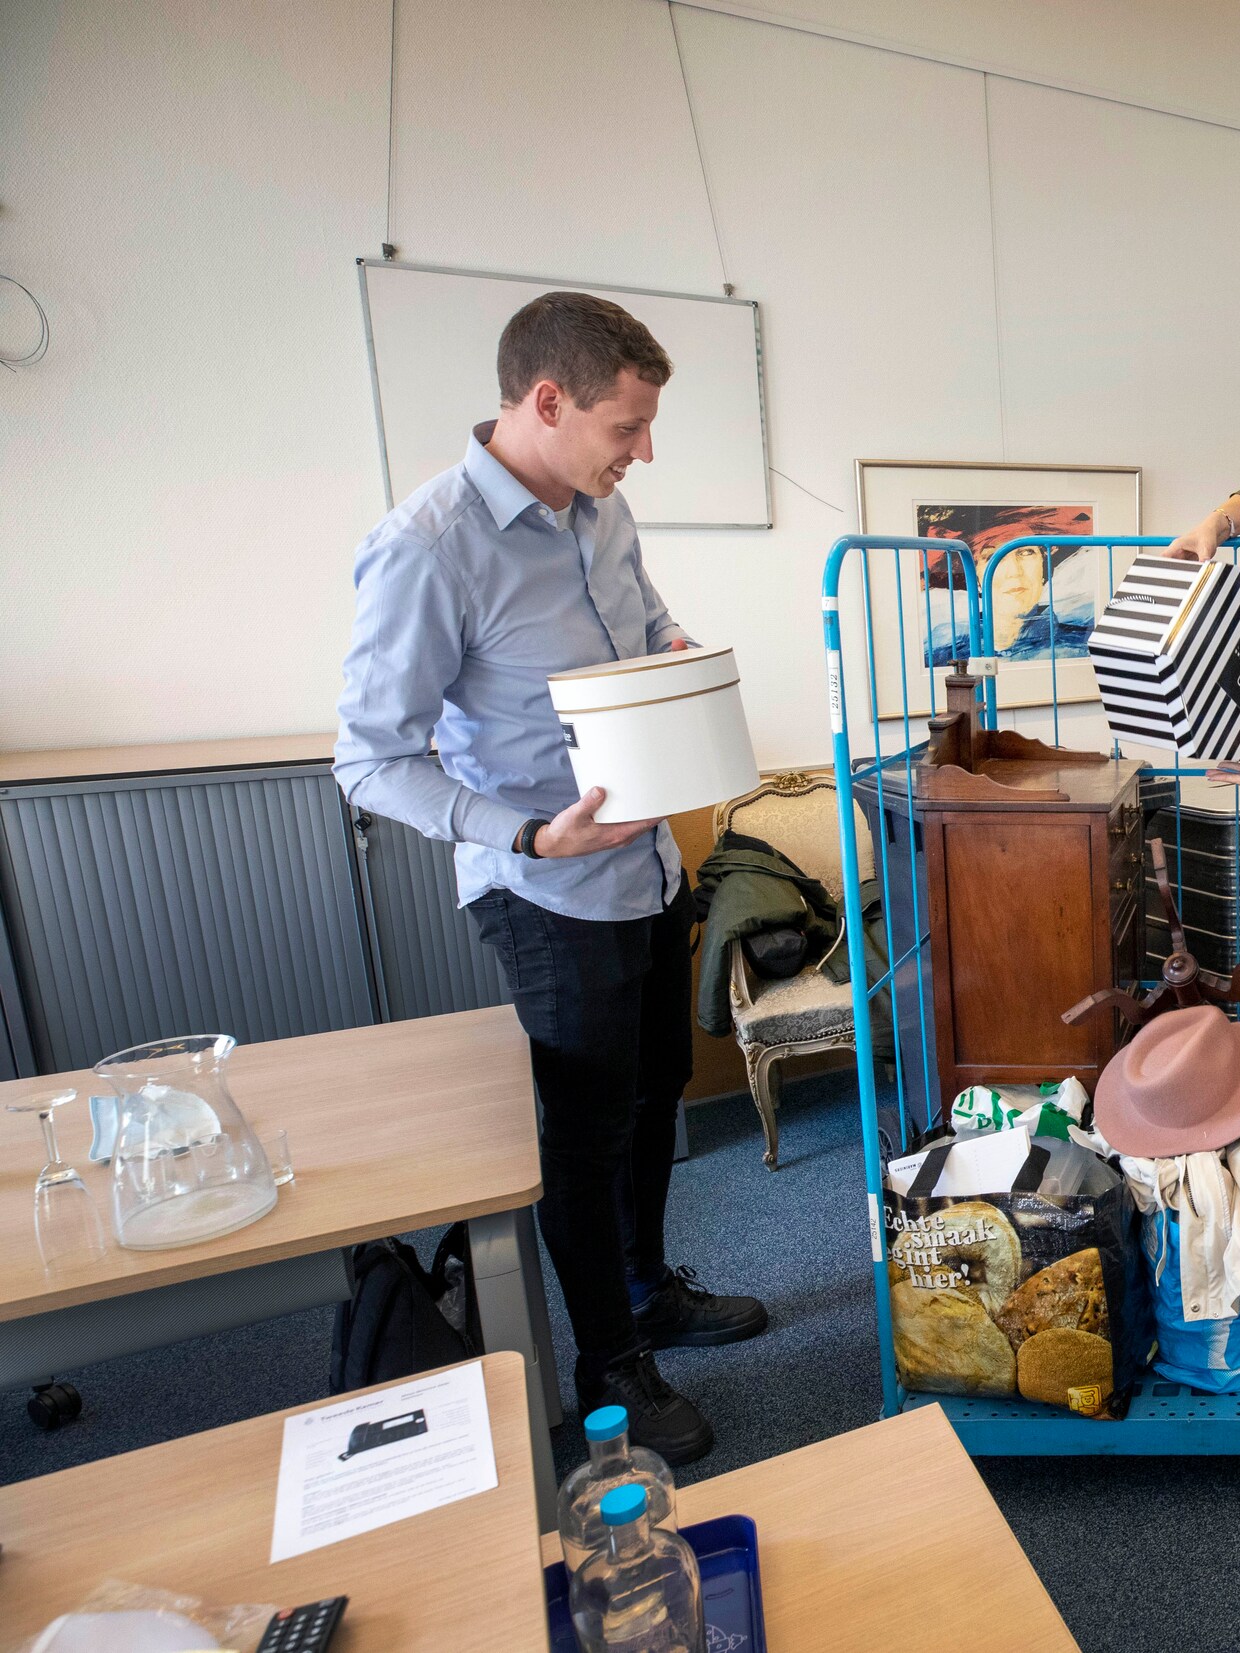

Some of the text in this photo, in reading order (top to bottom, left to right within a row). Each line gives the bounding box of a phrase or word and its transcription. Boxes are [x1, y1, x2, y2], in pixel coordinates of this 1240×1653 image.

[883, 1206, 945, 1233] Echte
[911, 1218, 998, 1249] smaak
[909, 1263, 971, 1290] hier!
